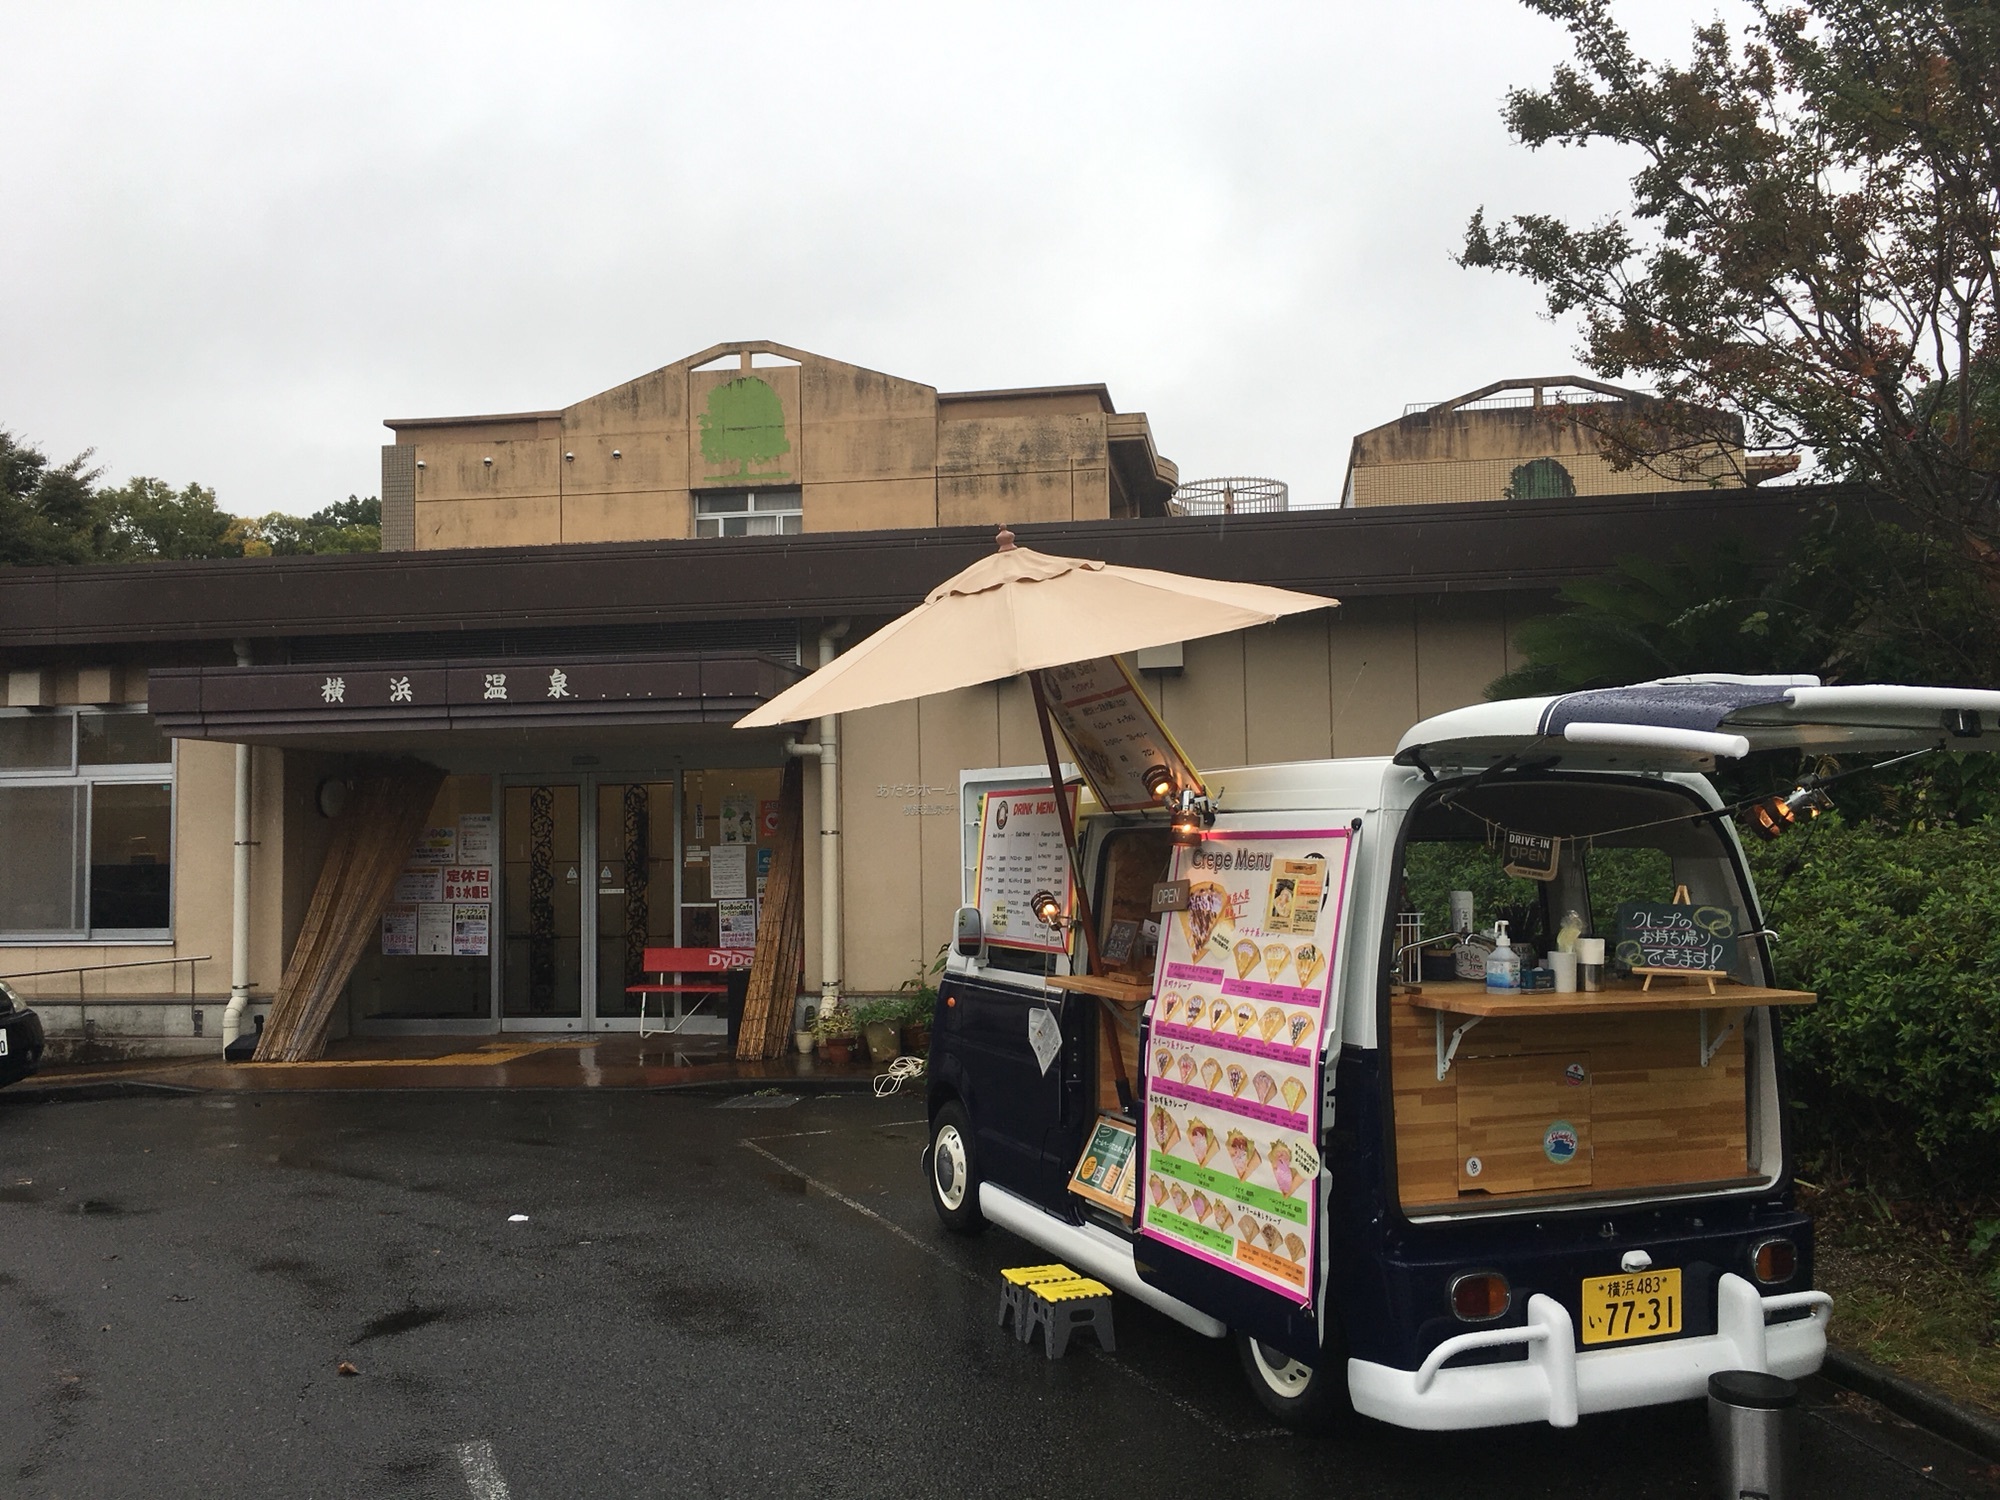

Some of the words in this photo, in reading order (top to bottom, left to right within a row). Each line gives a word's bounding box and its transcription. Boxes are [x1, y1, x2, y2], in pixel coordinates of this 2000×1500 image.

[321, 667, 570, 703] 横浜温泉
[876, 783, 958, 798] あだちホーム
[902, 803, 959, 817] 横浜温泉チ
[1013, 802, 1033, 816] DRINK
[1035, 800, 1057, 815] MENU
[1509, 833, 1550, 849] DRIVE-IN
[1191, 849, 1232, 874] Crepe
[1233, 849, 1273, 872] Menu
[1510, 845, 1547, 862] OPEN
[446, 870, 489, 883] 定休日
[446, 886, 489, 899] 第3水曜日
[1157, 887, 1181, 904] OPEN
[1631, 909, 1693, 929] クレープの
[1639, 928, 1712, 949] お持ち帰り
[708, 954, 754, 970] DyDo
[1458, 949, 1480, 961] Take
[1468, 962, 1484, 971] free
[1605, 1295, 1673, 1336] 77-31
